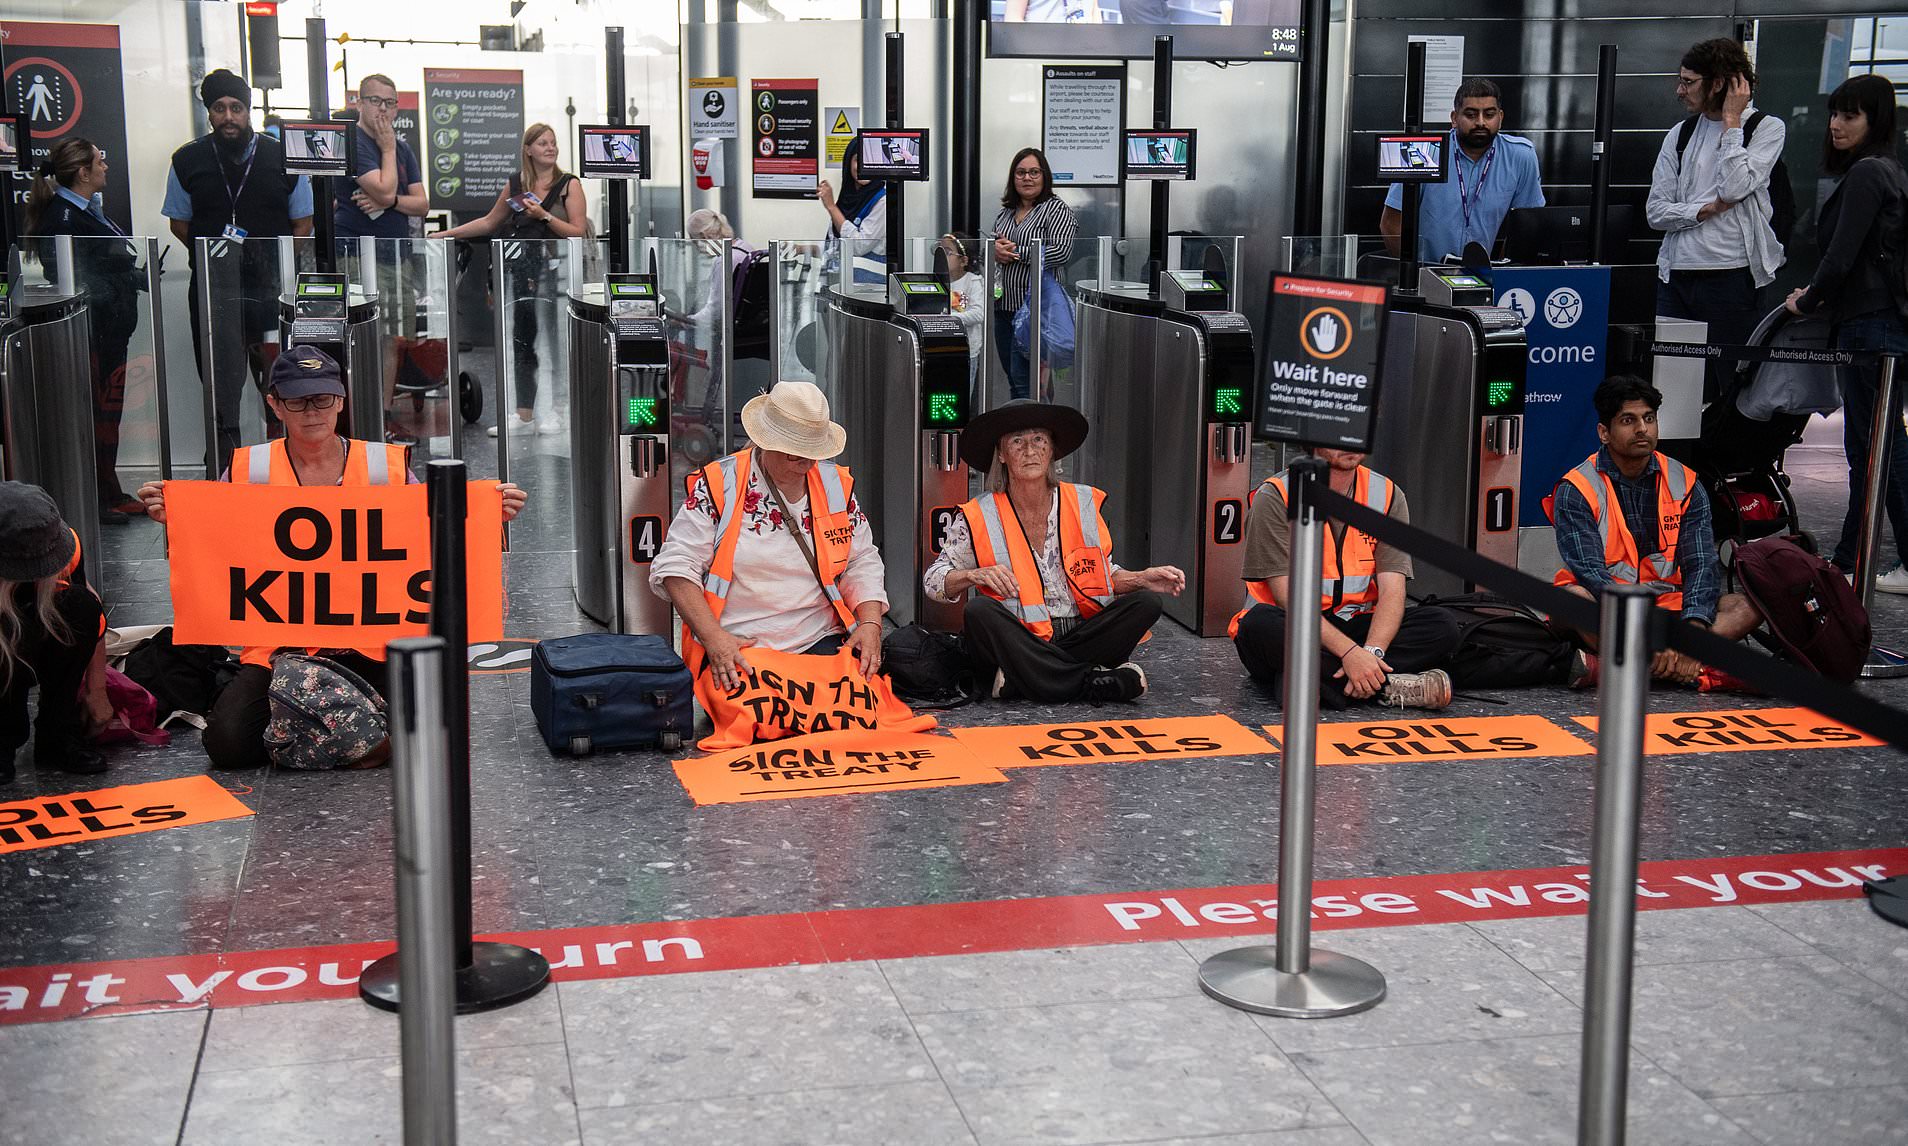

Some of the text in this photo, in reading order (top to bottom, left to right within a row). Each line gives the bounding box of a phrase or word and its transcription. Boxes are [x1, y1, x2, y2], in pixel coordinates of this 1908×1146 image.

[1272, 28, 1297, 40] 8:48
[1273, 42, 1277, 51] 1
[1279, 43, 1295, 53] Aug
[432, 88, 516, 100] Are you ready?
[1290, 284, 1315, 293] Prepare
[1326, 288, 1354, 297] Security
[1651, 344, 1721, 357] Authorised Access Only
[1770, 349, 1853, 364] Authorised Access Only
[1273, 361, 1367, 389] Wait here
[1270, 382, 1358, 401] Only move forward
[1269, 394, 1367, 412] when the gate is clear
[1495, 493, 1503, 527] 1
[938, 512, 952, 548] 3
[1220, 504, 1235, 540] 2
[273, 506, 408, 562] OIL
[638, 521, 656, 558] 4
[1082, 559, 1096, 567] THE
[229, 566, 432, 626] KILLS
[726, 666, 815, 706] SIGN
[1358, 724, 1479, 739] OIL
[1672, 714, 1796, 729] OIL
[1047, 725, 1168, 742] OIL
[1655, 727, 1862, 747] KILLS
[1018, 737, 1222, 760] KILLS
[1331, 737, 1538, 757] KILLS
[728, 748, 936, 773] SIGN THE
[750, 761, 924, 781] TREATY
[0, 798, 124, 826] OIL
[1436, 872, 1670, 909] wat
[1672, 864, 1887, 902] your
